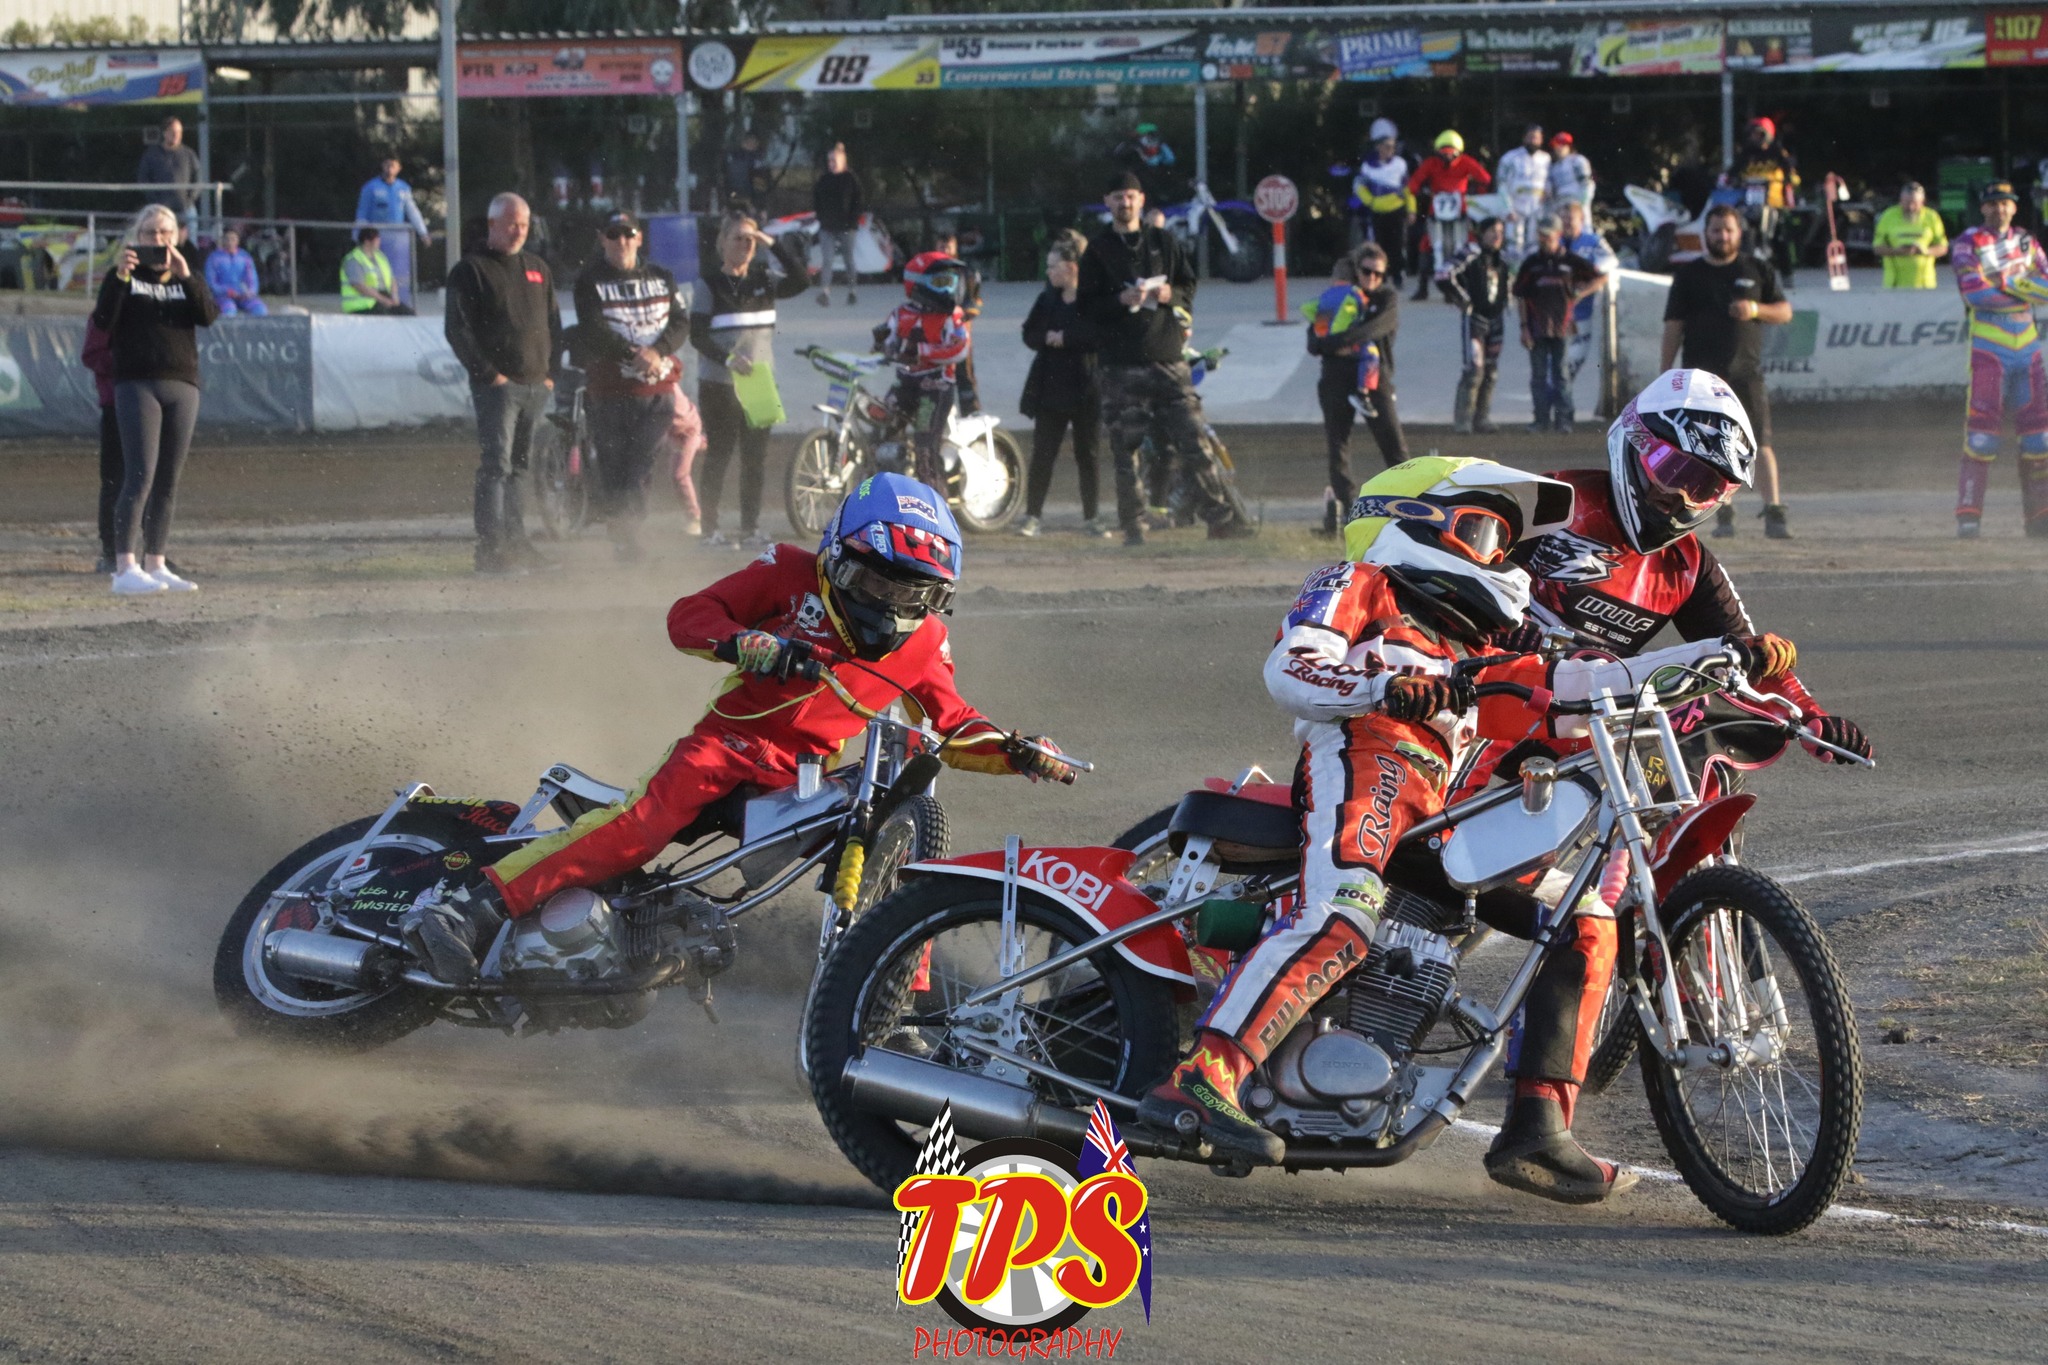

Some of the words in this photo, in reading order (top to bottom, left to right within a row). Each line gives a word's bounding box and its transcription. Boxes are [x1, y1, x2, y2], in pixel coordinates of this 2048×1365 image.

[1341, 33, 1415, 60] PRIME
[818, 55, 869, 84] 89
[944, 68, 1053, 83] Commercial
[1057, 66, 1124, 82] Driving
[1258, 188, 1295, 210] STOP
[1575, 595, 1655, 632] WULF
[1583, 621, 1606, 634] EST
[1282, 659, 1359, 697] Racing
[1020, 850, 1113, 912] KOBI
[357, 886, 388, 897] KEEP
[393, 890, 409, 899] IT
[1335, 888, 1382, 909] ROCK
[351, 899, 412, 913] TWISTED
[1321, 1059, 1371, 1070] HONDA
